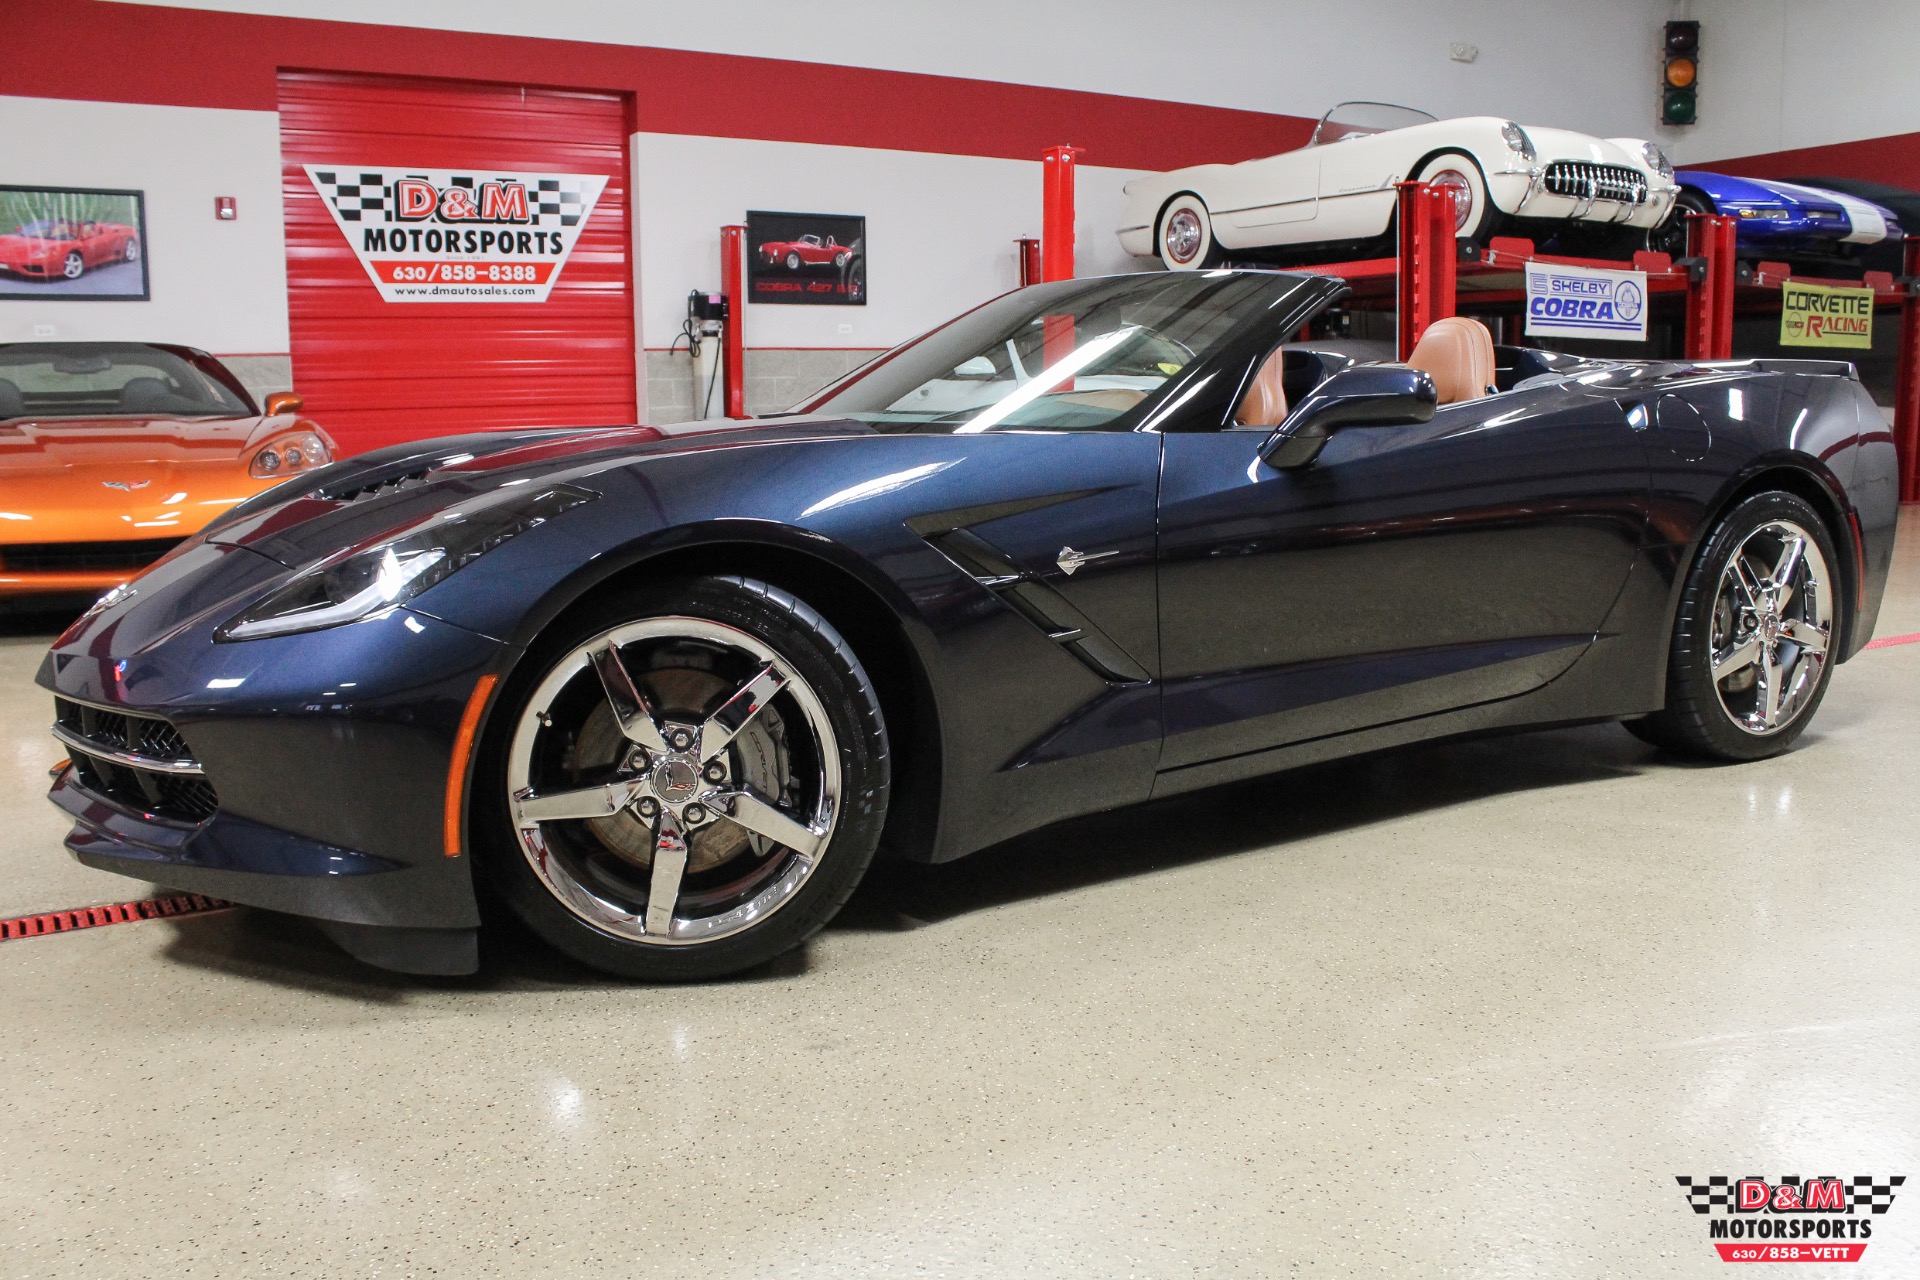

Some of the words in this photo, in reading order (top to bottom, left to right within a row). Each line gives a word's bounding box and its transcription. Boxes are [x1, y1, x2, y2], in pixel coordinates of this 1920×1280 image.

[395, 179, 530, 223] D&M
[363, 228, 563, 254] MOTORSPORTS
[393, 264, 536, 282] 630/858-8388
[395, 285, 536, 295] www.dmautosales.com
[755, 283, 802, 292] COBRA
[807, 283, 833, 292] 427
[1552, 279, 1607, 294] SHELBY
[1530, 297, 1614, 320] COBRA
[1786, 291, 1869, 314] CORVETTE
[1806, 315, 1868, 338] RACING
